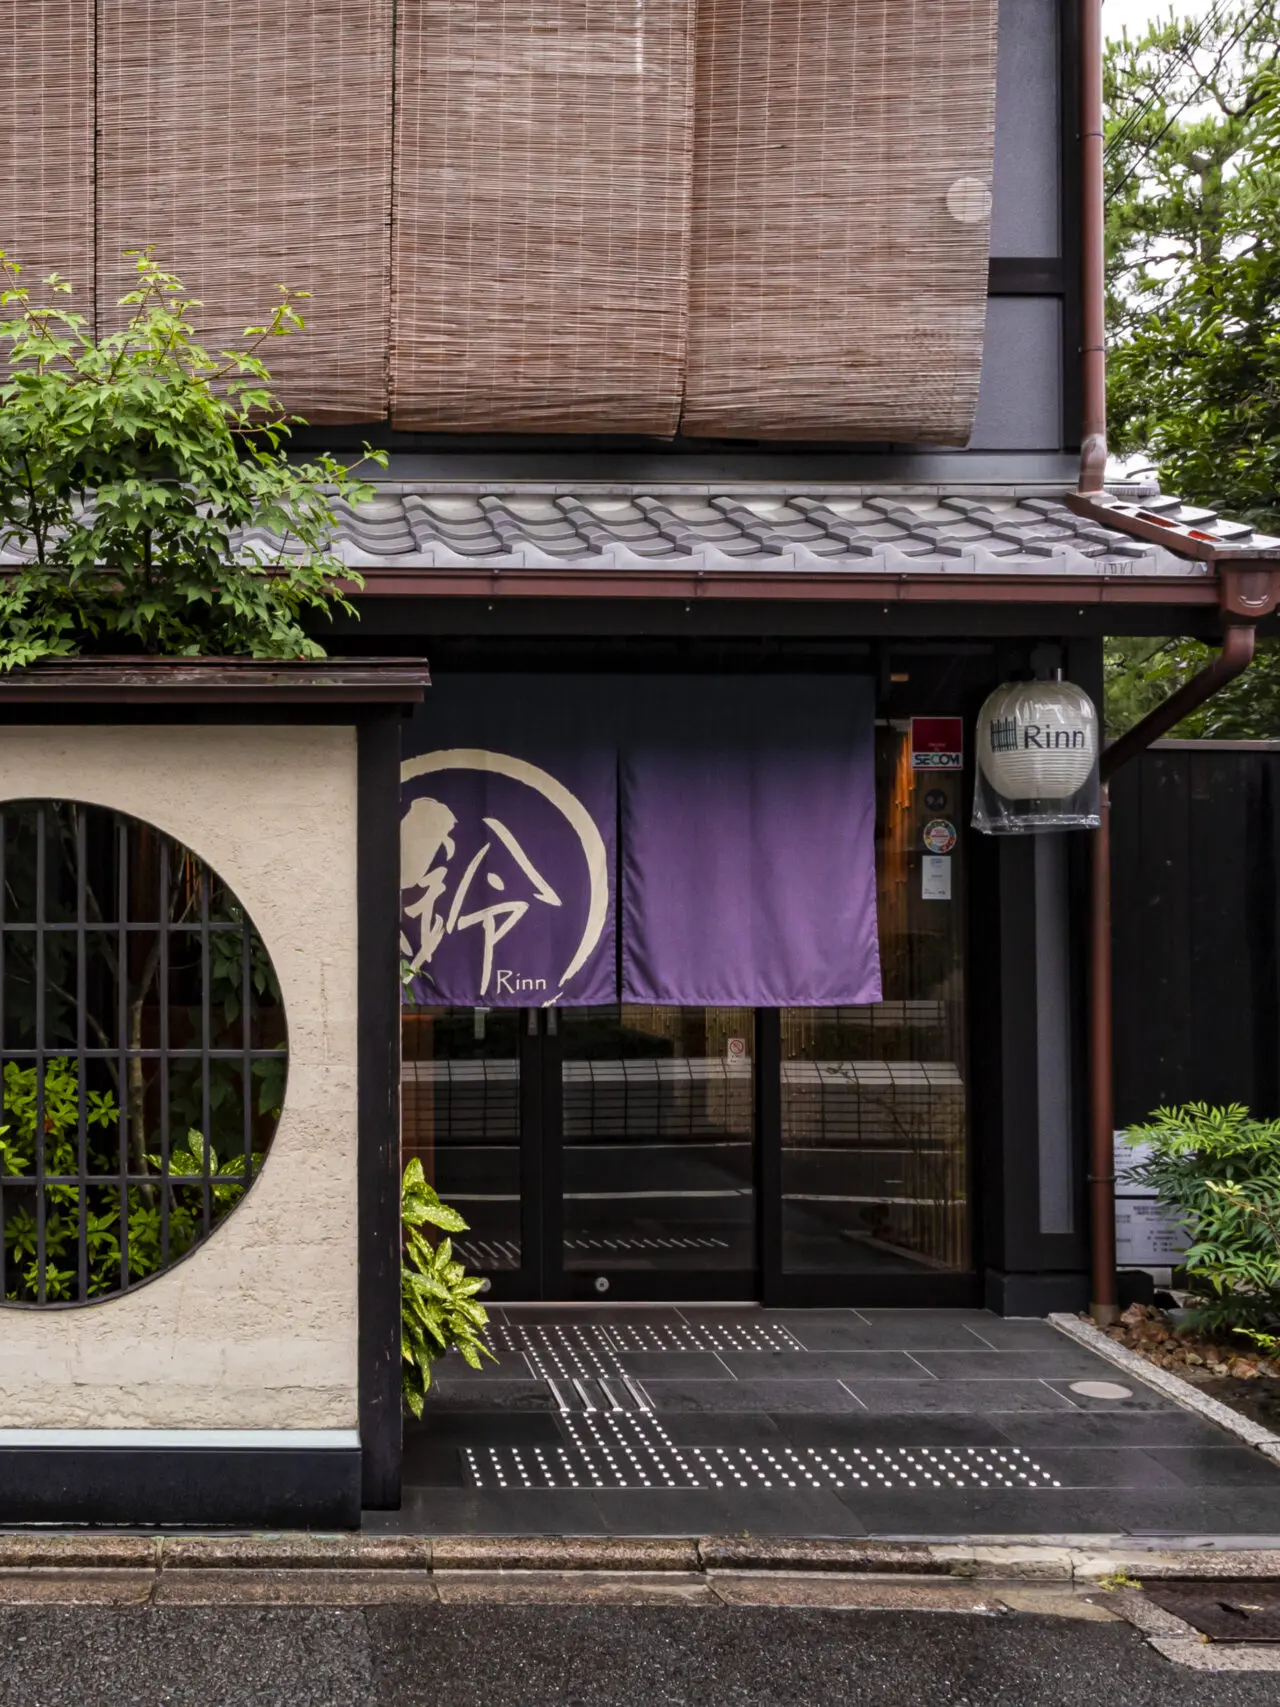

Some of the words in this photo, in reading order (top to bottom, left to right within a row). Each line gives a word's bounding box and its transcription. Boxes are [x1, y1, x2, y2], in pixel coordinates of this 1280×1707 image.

[1023, 723, 1085, 750] Rinn
[914, 753, 960, 766] SECOM
[496, 969, 547, 995] Rinn
